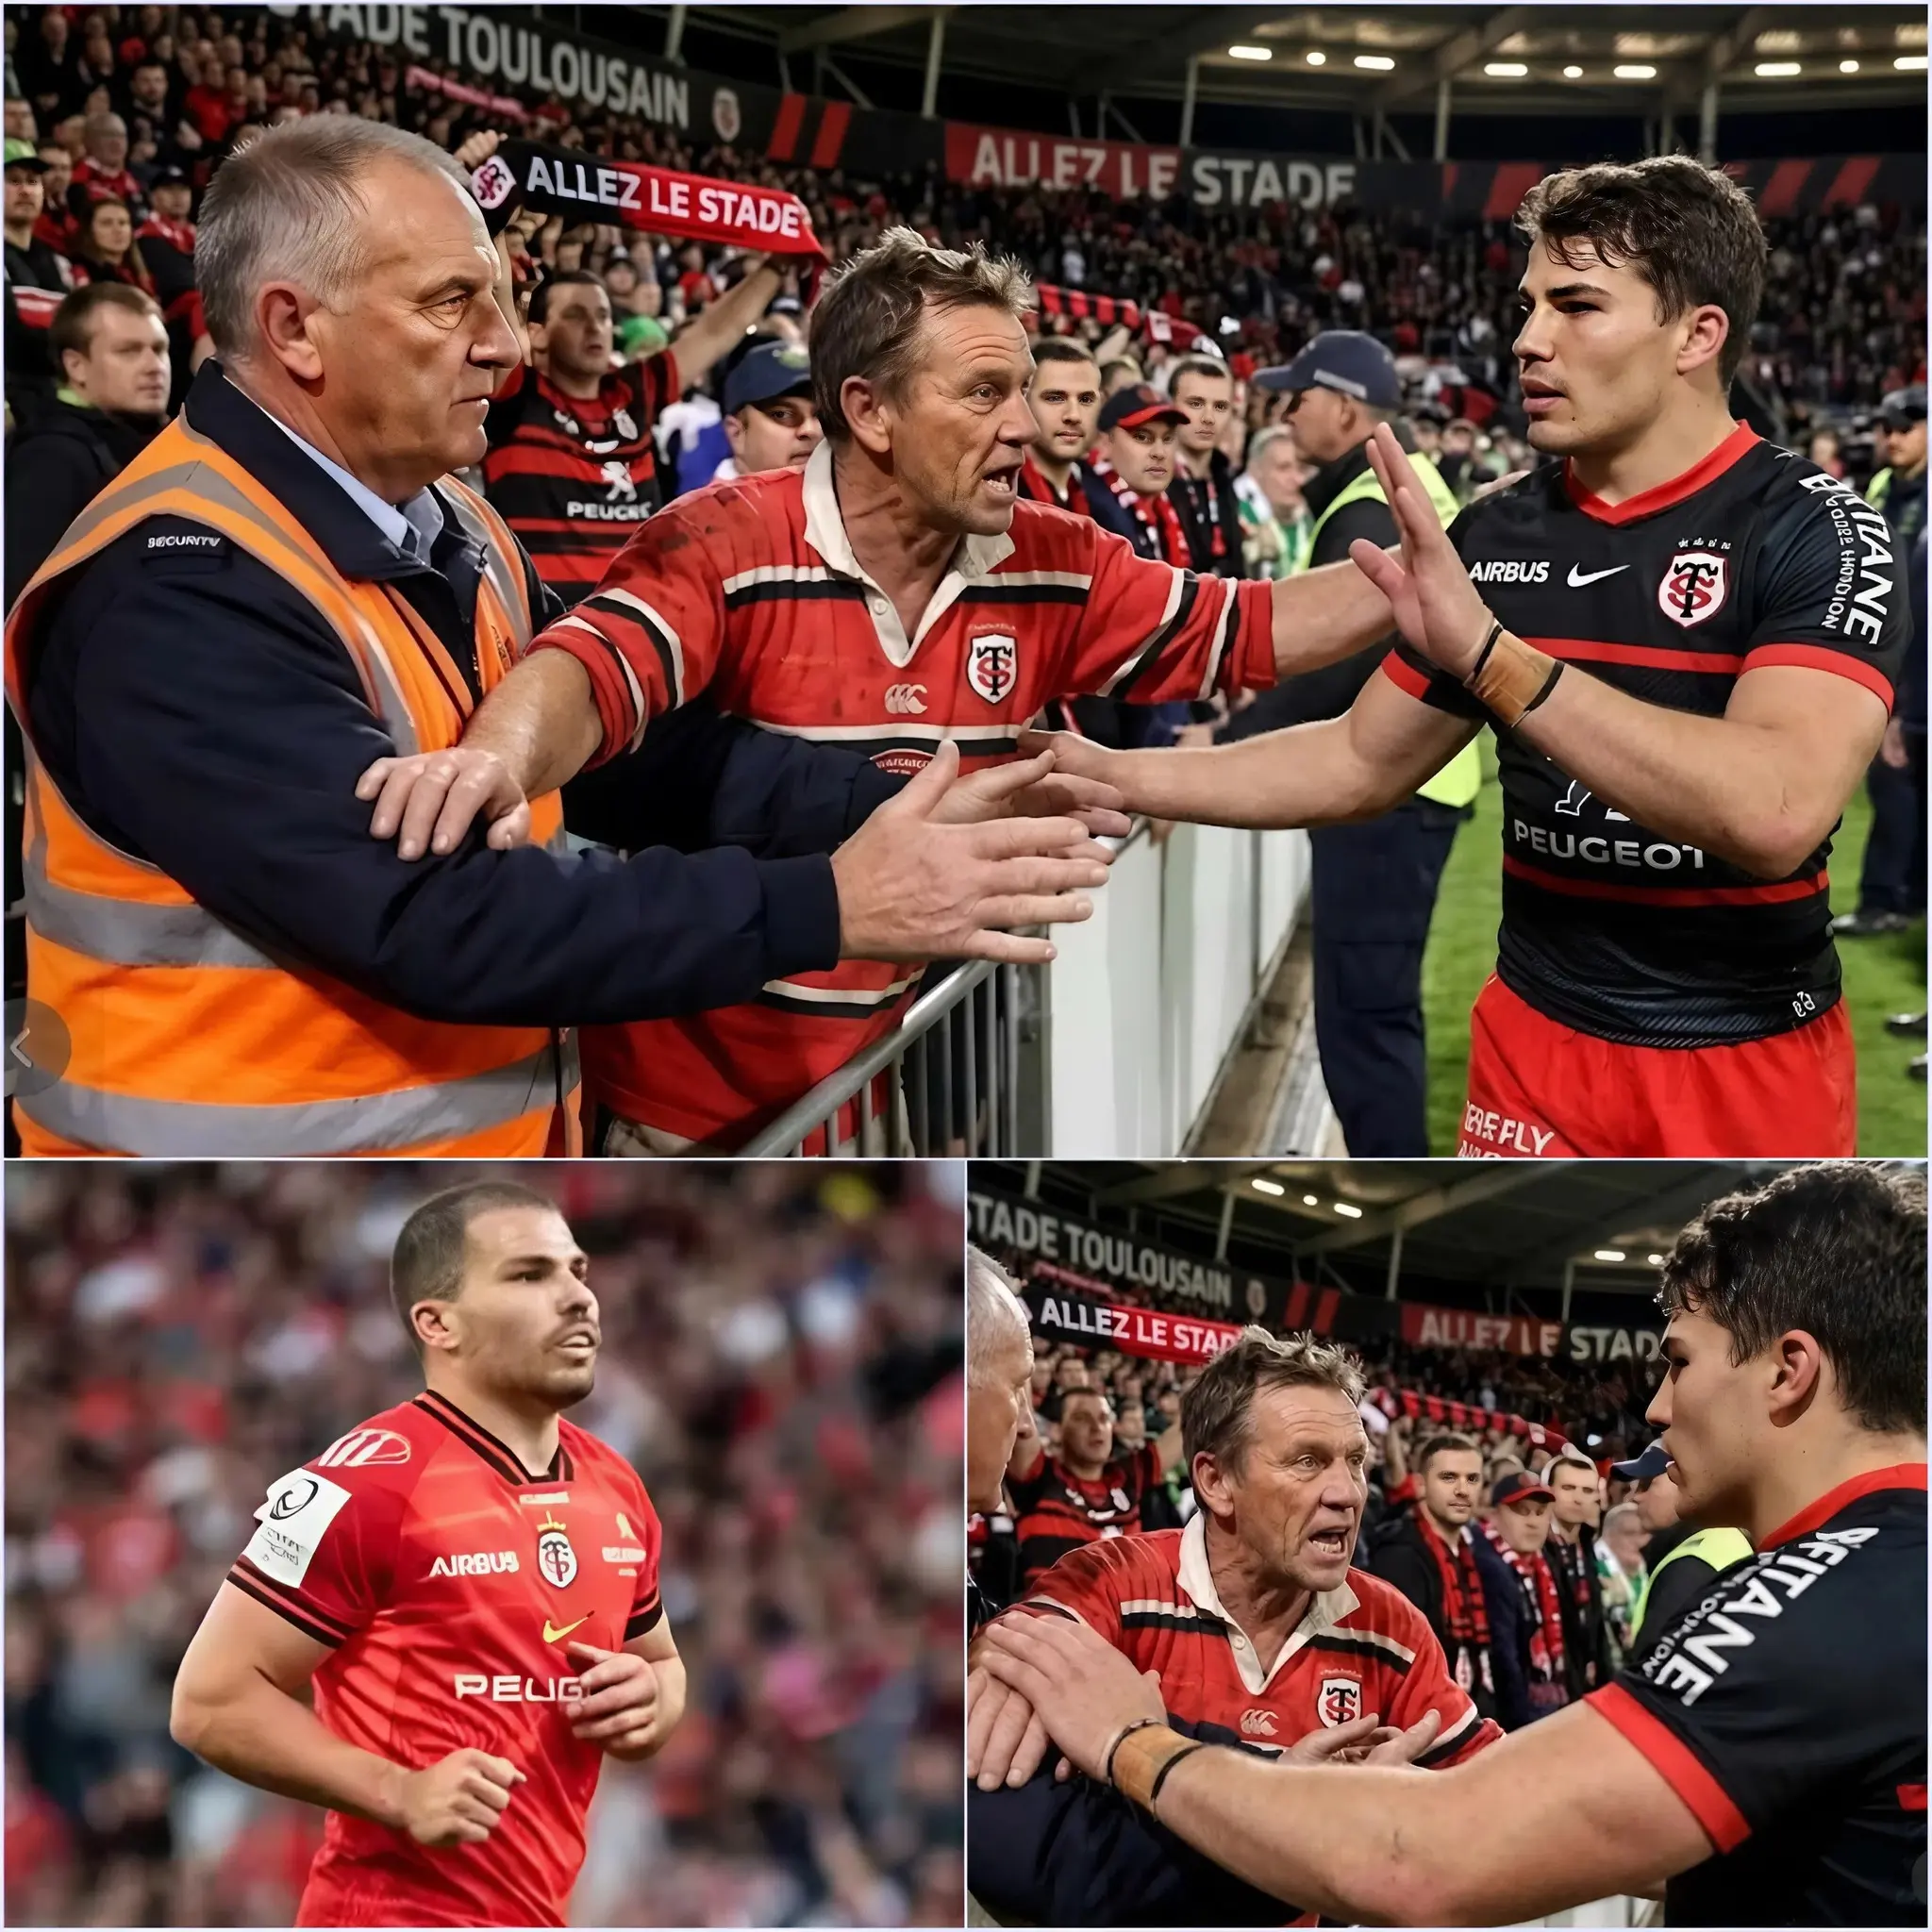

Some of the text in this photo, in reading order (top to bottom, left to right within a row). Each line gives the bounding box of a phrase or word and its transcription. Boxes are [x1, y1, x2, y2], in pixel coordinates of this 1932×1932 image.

[439, 7, 689, 130] TOULOUSAIN
[526, 156, 801, 238] ALLEZ LE STADE
[1121, 152, 1177, 201] LE
[1469, 561, 1550, 583] AIRBUS
[1513, 819, 1704, 870] PEUGEOT
[967, 1191, 1232, 1307] TADE TOULOUSAIN
[1041, 1297, 1243, 1357] ALLEZ LE STAD
[429, 1551, 520, 1577] AIRBUS
